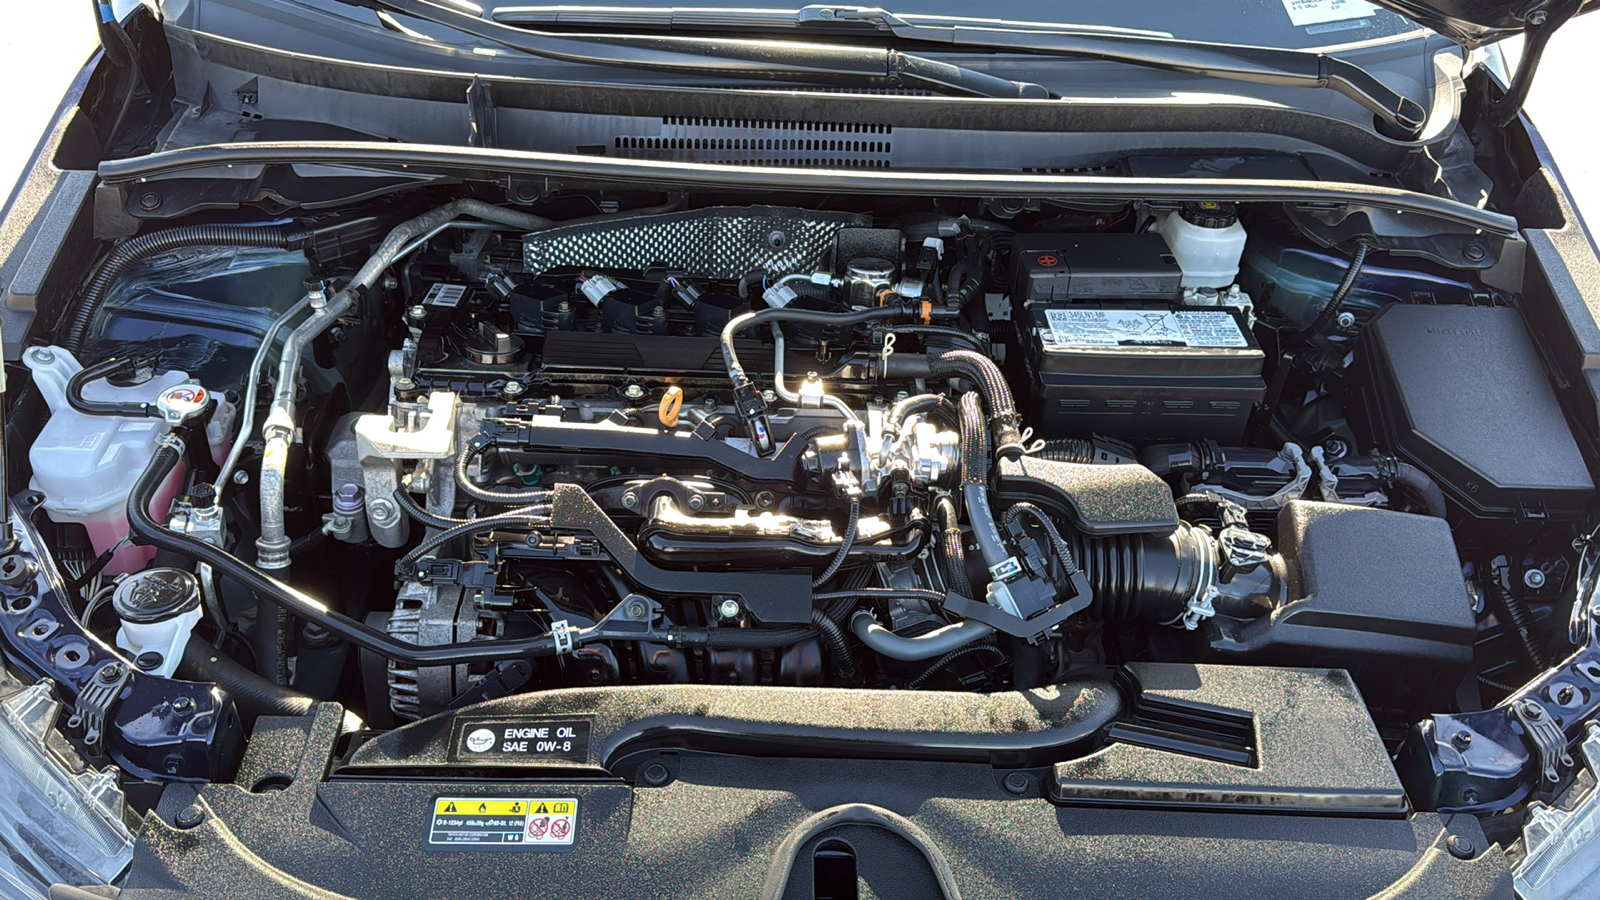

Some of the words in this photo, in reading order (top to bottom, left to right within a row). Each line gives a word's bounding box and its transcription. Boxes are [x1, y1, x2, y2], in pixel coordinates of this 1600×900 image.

[504, 727, 549, 739] ENGINE
[556, 727, 576, 738] OIL
[502, 741, 528, 752] SAE
[536, 741, 571, 752] 0W-8
